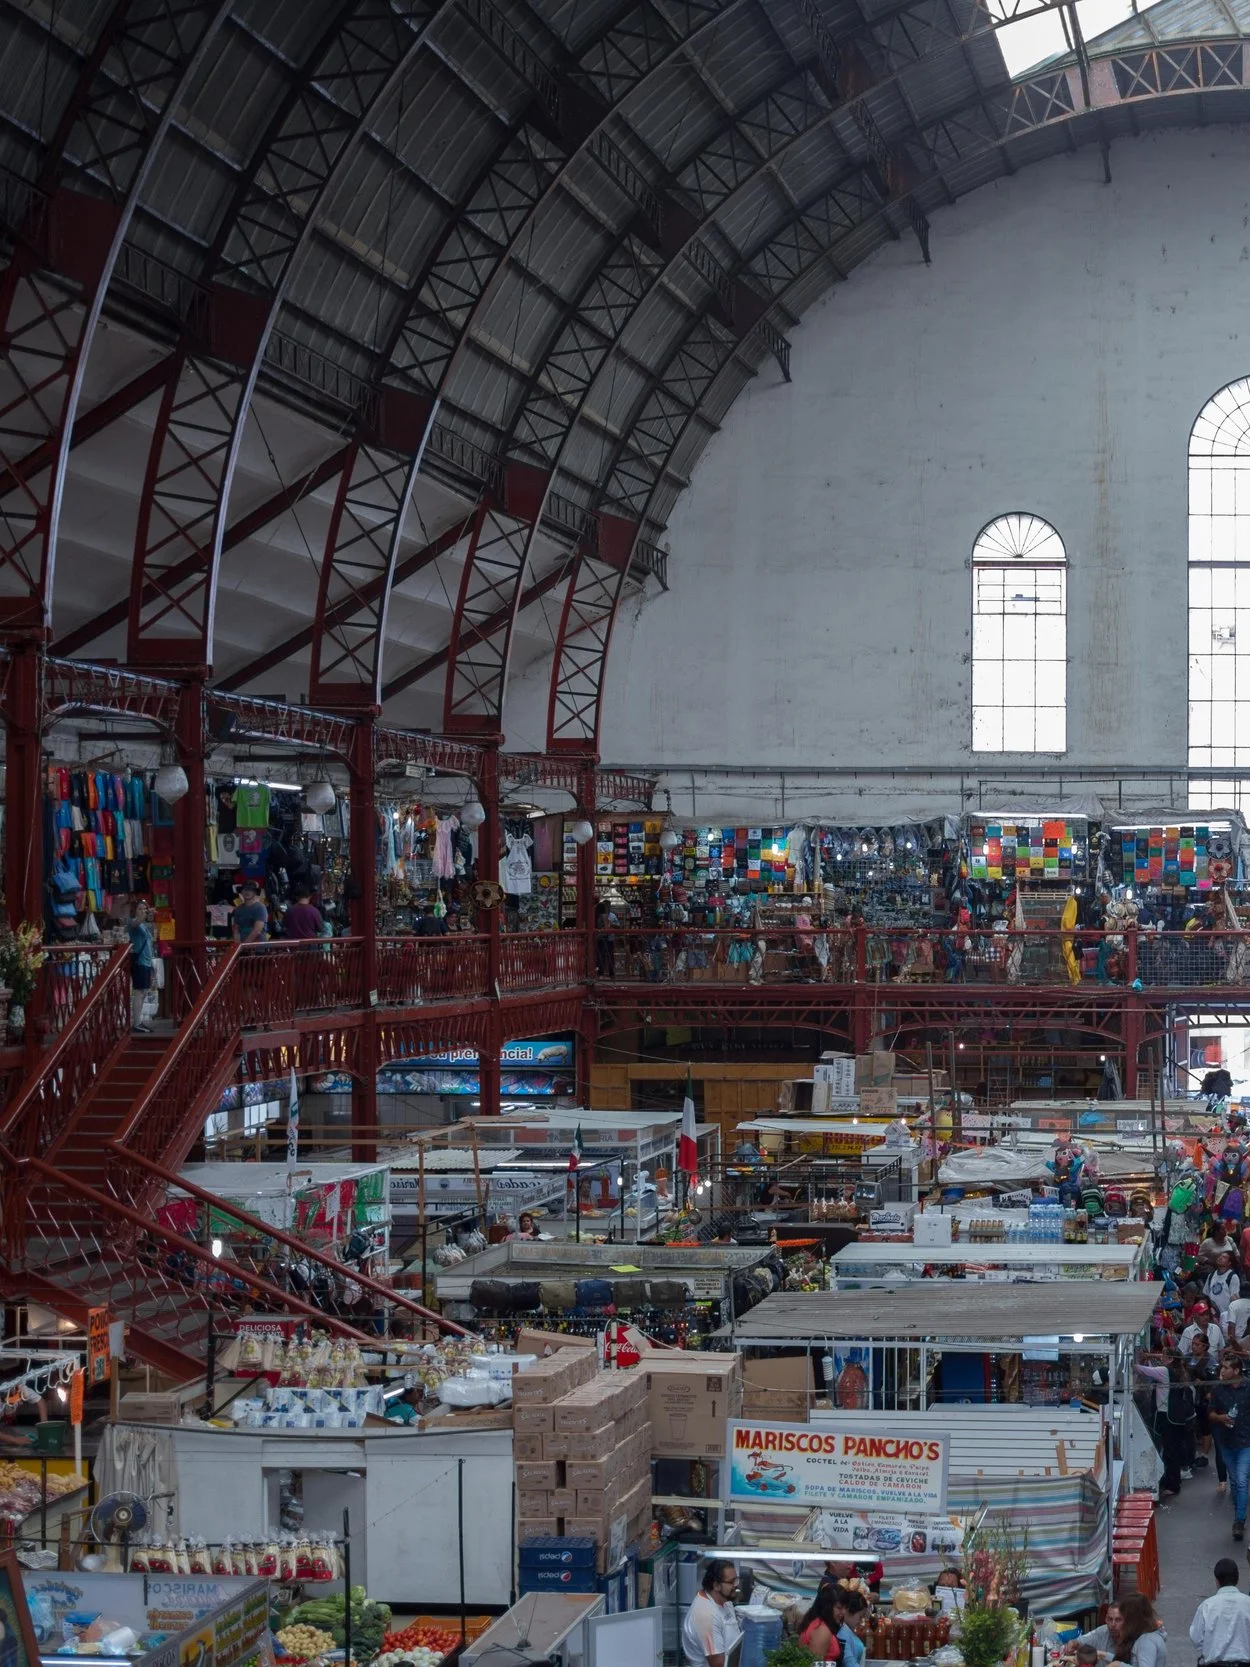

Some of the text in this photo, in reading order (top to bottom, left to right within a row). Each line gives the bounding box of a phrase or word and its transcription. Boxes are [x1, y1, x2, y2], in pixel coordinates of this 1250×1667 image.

[735, 1429, 941, 1462] MARISCOS PANCHO'S
[806, 1457, 837, 1465] COCTEL
[839, 1473, 881, 1482] TOSTADAS
[804, 1484, 825, 1492] SOPA
[882, 1482, 922, 1490] CAMARON
[804, 1490, 828, 1498] FILETE
[829, 1511, 854, 1519] VUELVE
